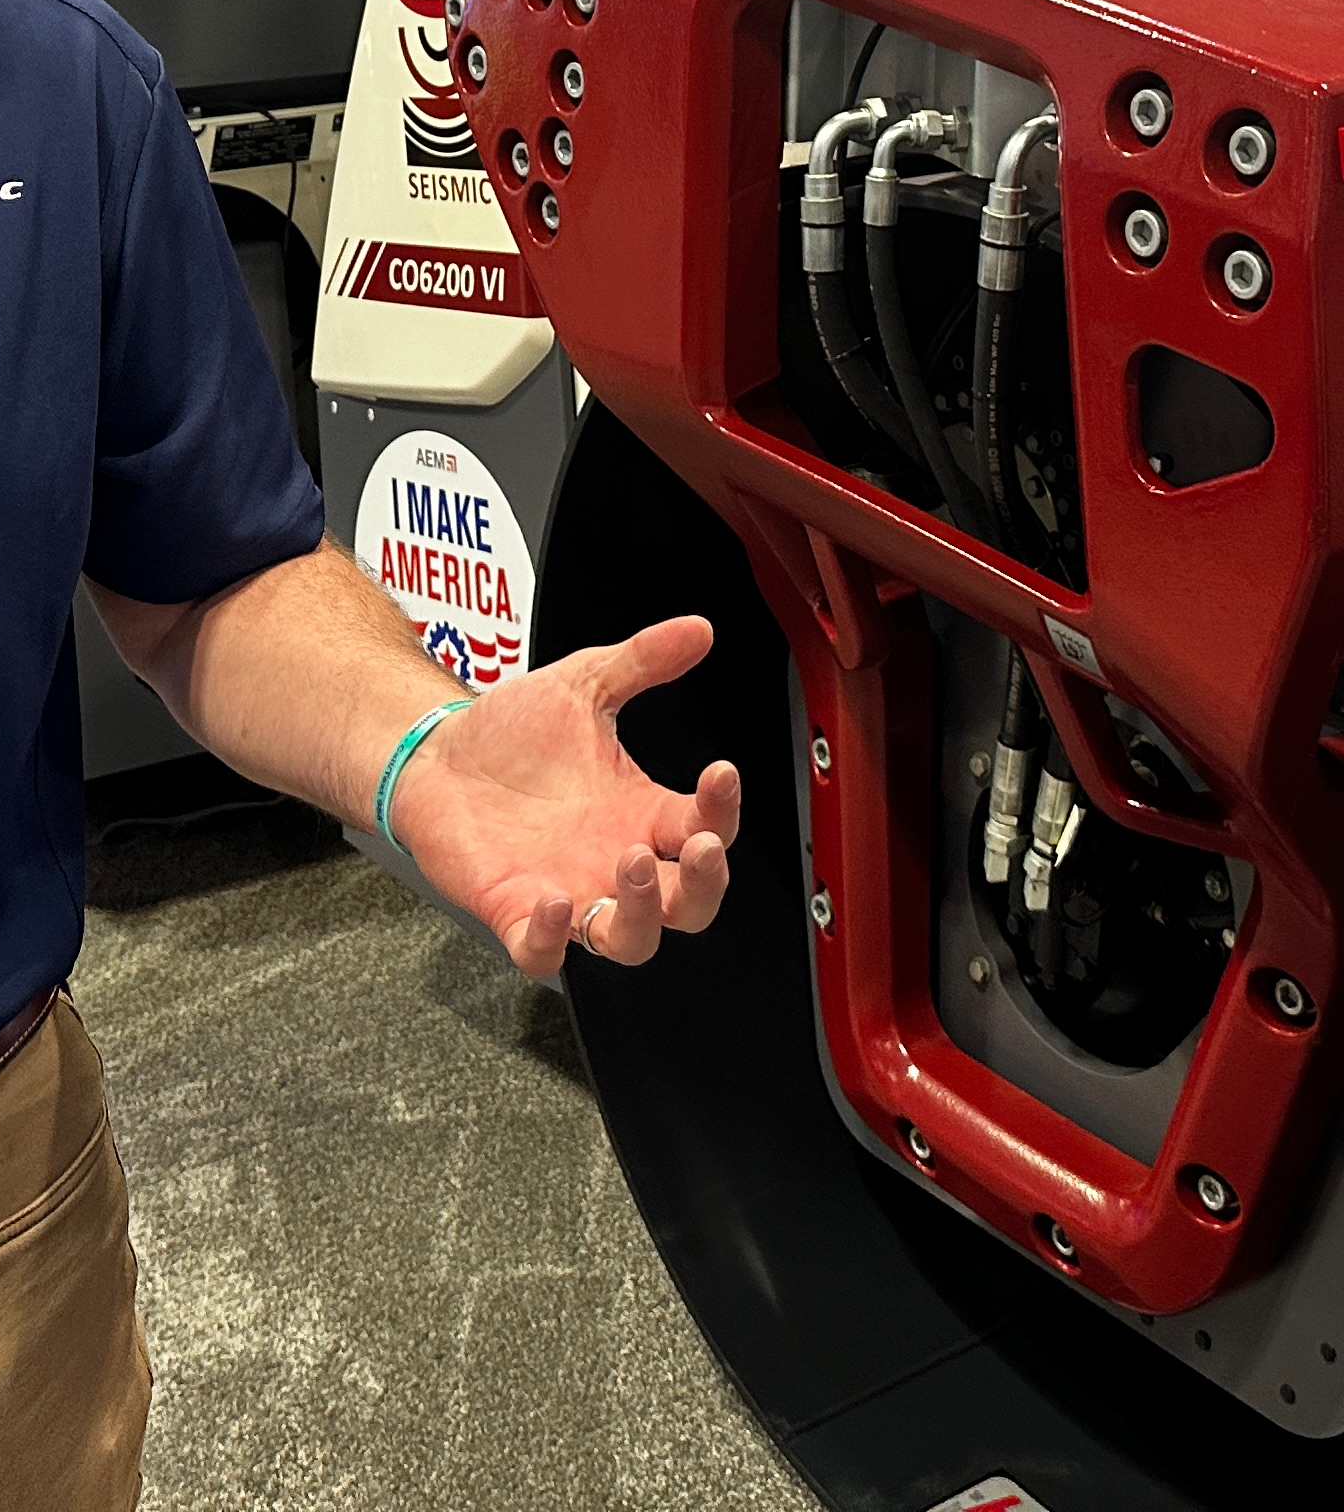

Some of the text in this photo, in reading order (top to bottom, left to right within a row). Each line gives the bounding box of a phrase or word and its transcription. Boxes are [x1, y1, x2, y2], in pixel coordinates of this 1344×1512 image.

[408, 172, 492, 204] SEISMIC
[388, 256, 505, 301] CO6200 VI
[416, 447, 445, 470] AEM
[392, 477, 492, 554] I MAKE
[381, 536, 514, 624] AMERICA
